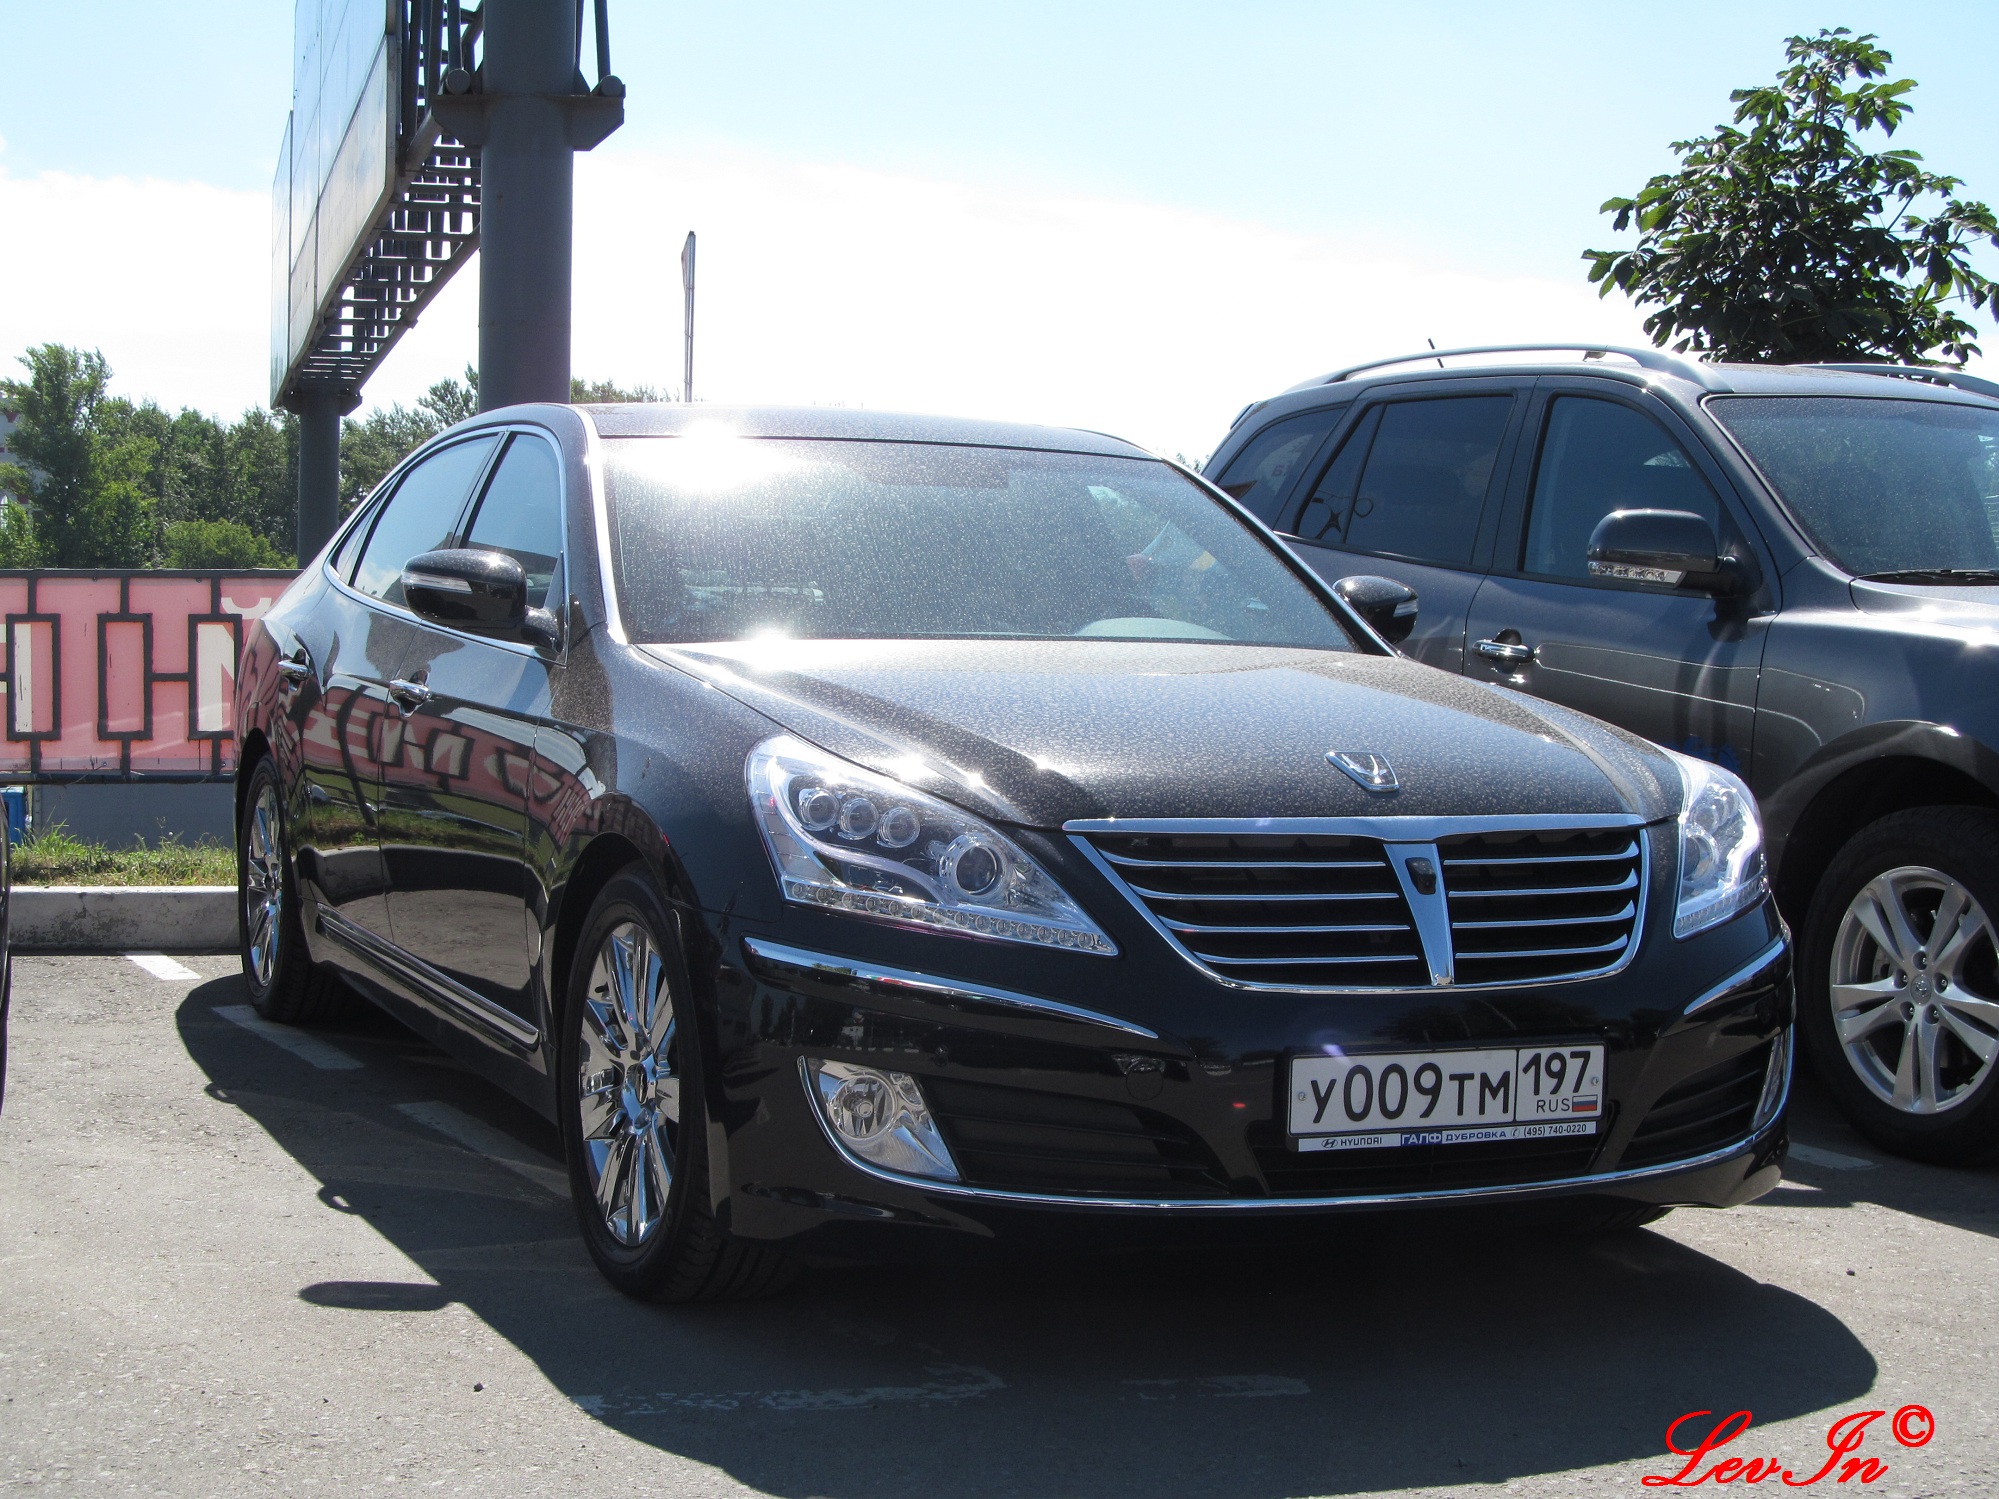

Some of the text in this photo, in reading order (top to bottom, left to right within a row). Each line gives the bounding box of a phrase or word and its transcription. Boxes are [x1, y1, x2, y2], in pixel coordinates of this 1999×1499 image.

[1521, 1050, 1591, 1096] 197
[1535, 1098, 1570, 1113] RUS
[1339, 1136, 1382, 1147] HYUNDAI
[1445, 1130, 1507, 1142] ДУБРОВКА
[1523, 1126, 1546, 1137] (495)
[1548, 1123, 1587, 1135] 740-0220
